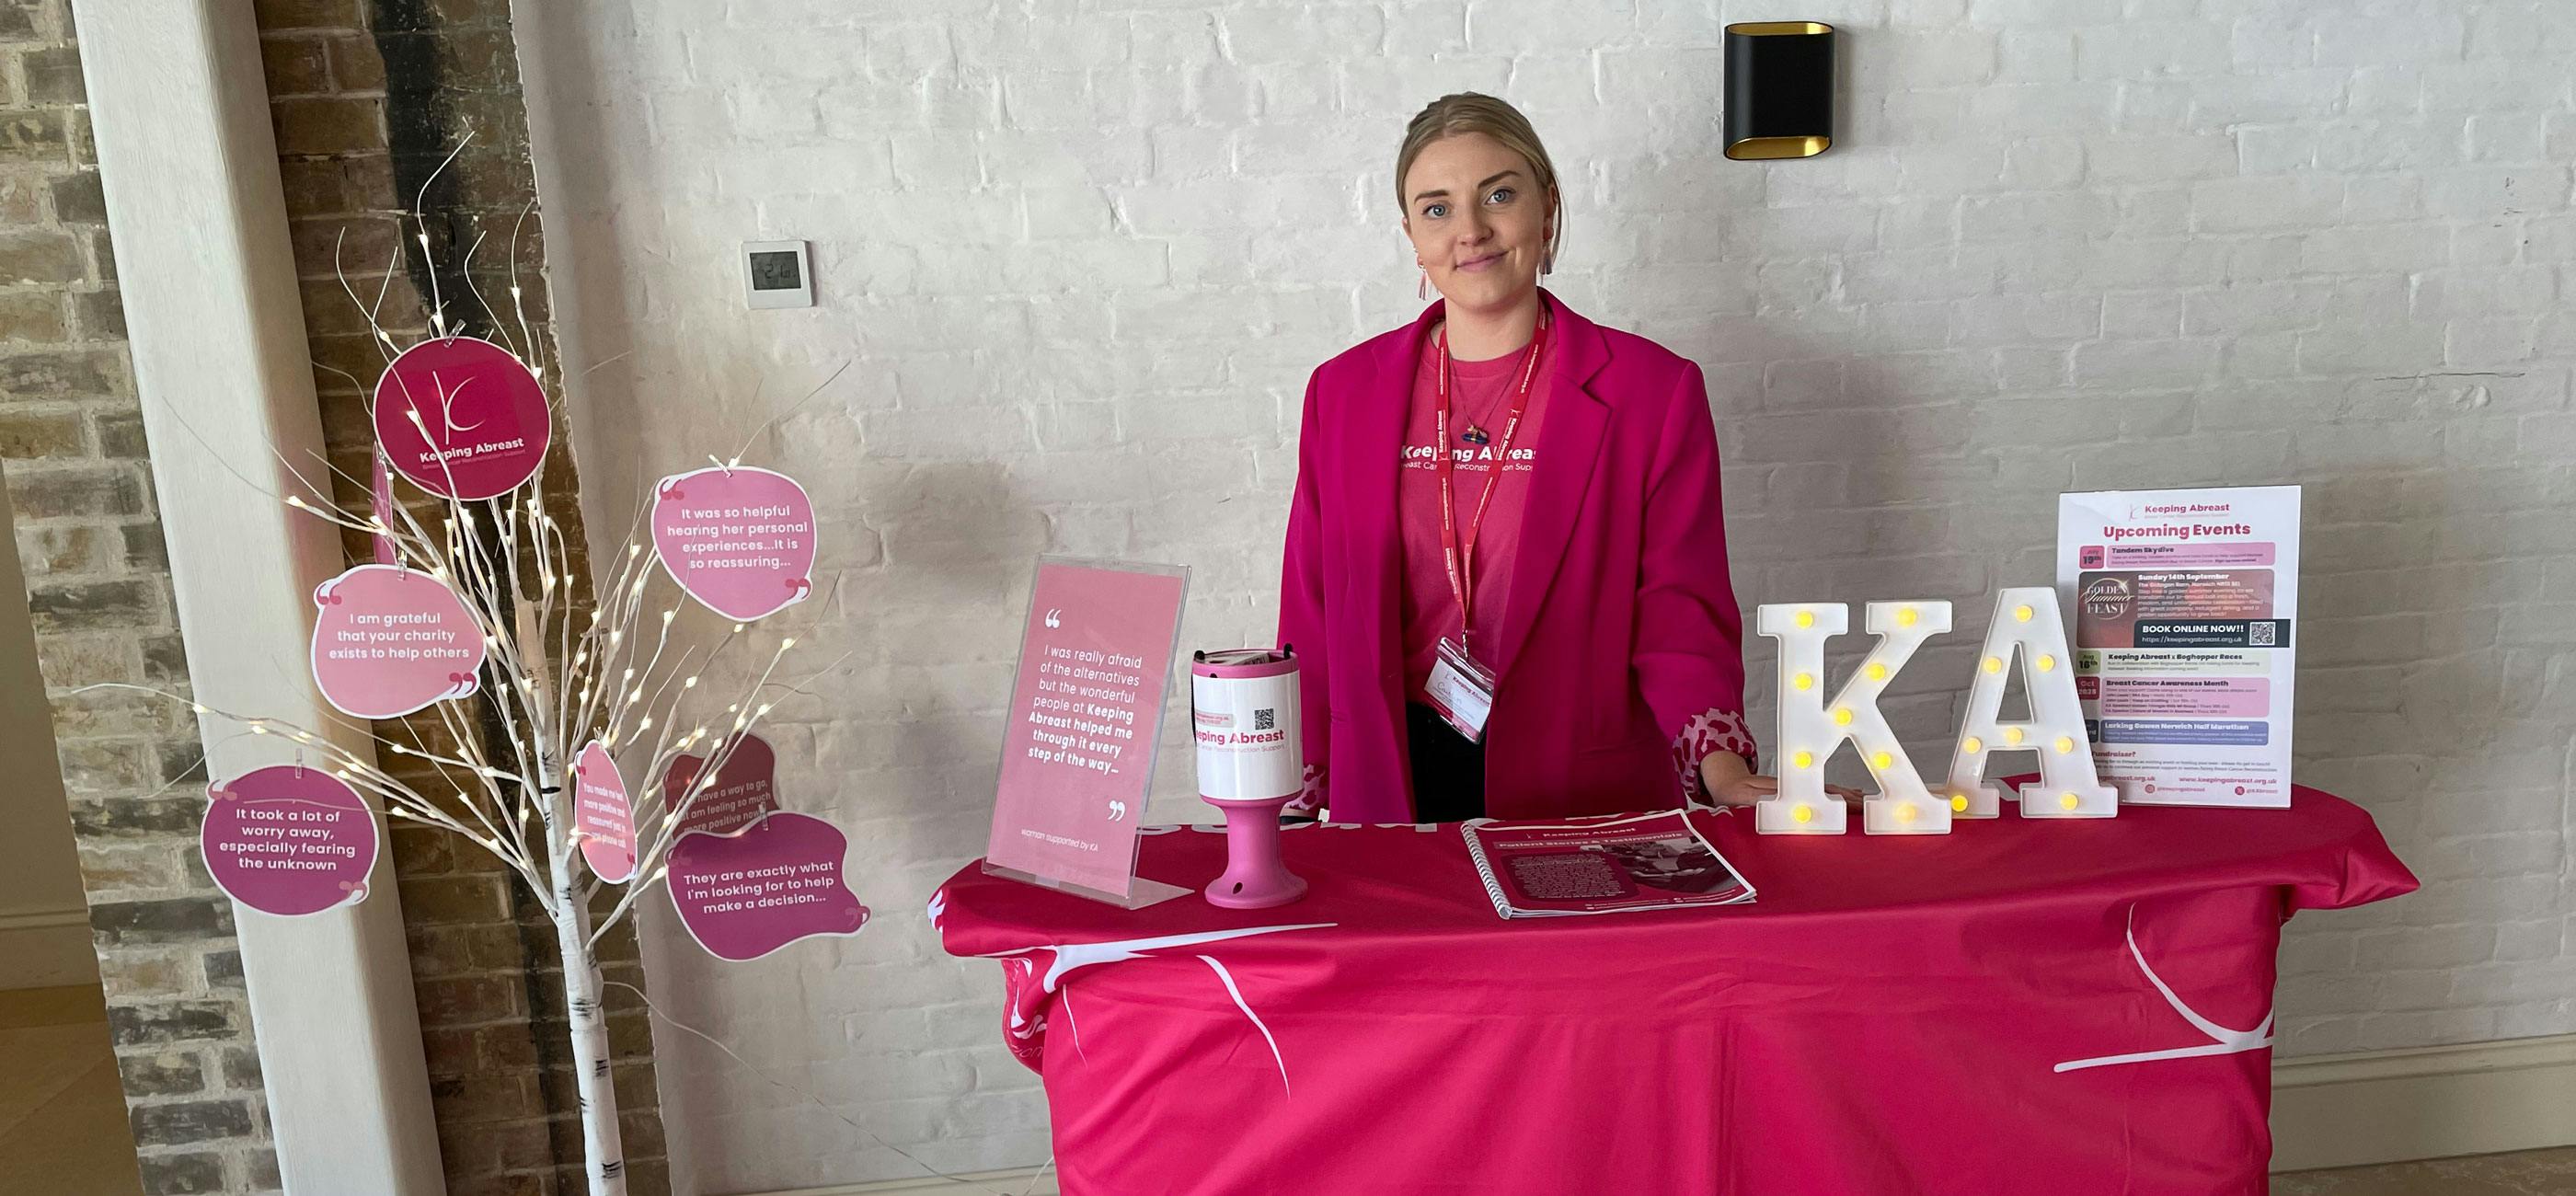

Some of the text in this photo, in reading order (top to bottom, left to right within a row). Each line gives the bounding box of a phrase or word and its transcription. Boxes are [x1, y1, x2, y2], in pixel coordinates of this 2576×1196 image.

[476, 438, 524, 454] Abreast
[1401, 445, 1474, 462] Keeng
[682, 505, 790, 520] It was so helpful
[2145, 503, 2229, 513] Keeping Abreast
[667, 522, 808, 538] hearing her personal
[2104, 523, 2251, 541] Upcoming Events
[787, 537, 799, 549] is
[690, 556, 791, 569] so reassuring...
[2186, 573, 2230, 581] September
[2087, 604, 2125, 614] FEAST
[350, 613, 441, 627] I am grateful
[338, 629, 455, 644] that your charity
[2211, 625, 2244, 633] NOW!!
[329, 647, 470, 661] exists to help others
[1044, 645, 1143, 669] I was really afraid
[1041, 661, 1140, 686] of the alternatives
[1039, 678, 1135, 703] but the wonderful
[1033, 696, 1134, 725] people at Keeping
[1029, 711, 1133, 740] Abreast helped me
[2105, 722, 2133, 730] Larking
[1033, 729, 1122, 759] through it every
[1229, 730, 1284, 744] Abreast
[1028, 747, 1052, 764] step
[1053, 751, 1065, 763] of
[1067, 753, 1086, 767] the
[728, 786, 745, 796] way
[746, 782, 754, 791] to
[691, 792, 771, 819] am feeling so much
[236, 809, 340, 822] It took a lot of
[708, 813, 742, 831] positive
[241, 825, 335, 841] worry away,
[1592, 827, 1637, 835] Abreast
[1604, 832, 1684, 844] Testimonials
[1021, 828, 1098, 852] woman supported by KA
[219, 842, 356, 858] especially fearing
[238, 857, 337, 870] the unknown
[684, 861, 834, 885] They are exactly what
[687, 876, 834, 900] I'm looking for to help
[703, 893, 826, 914] make a decision...
